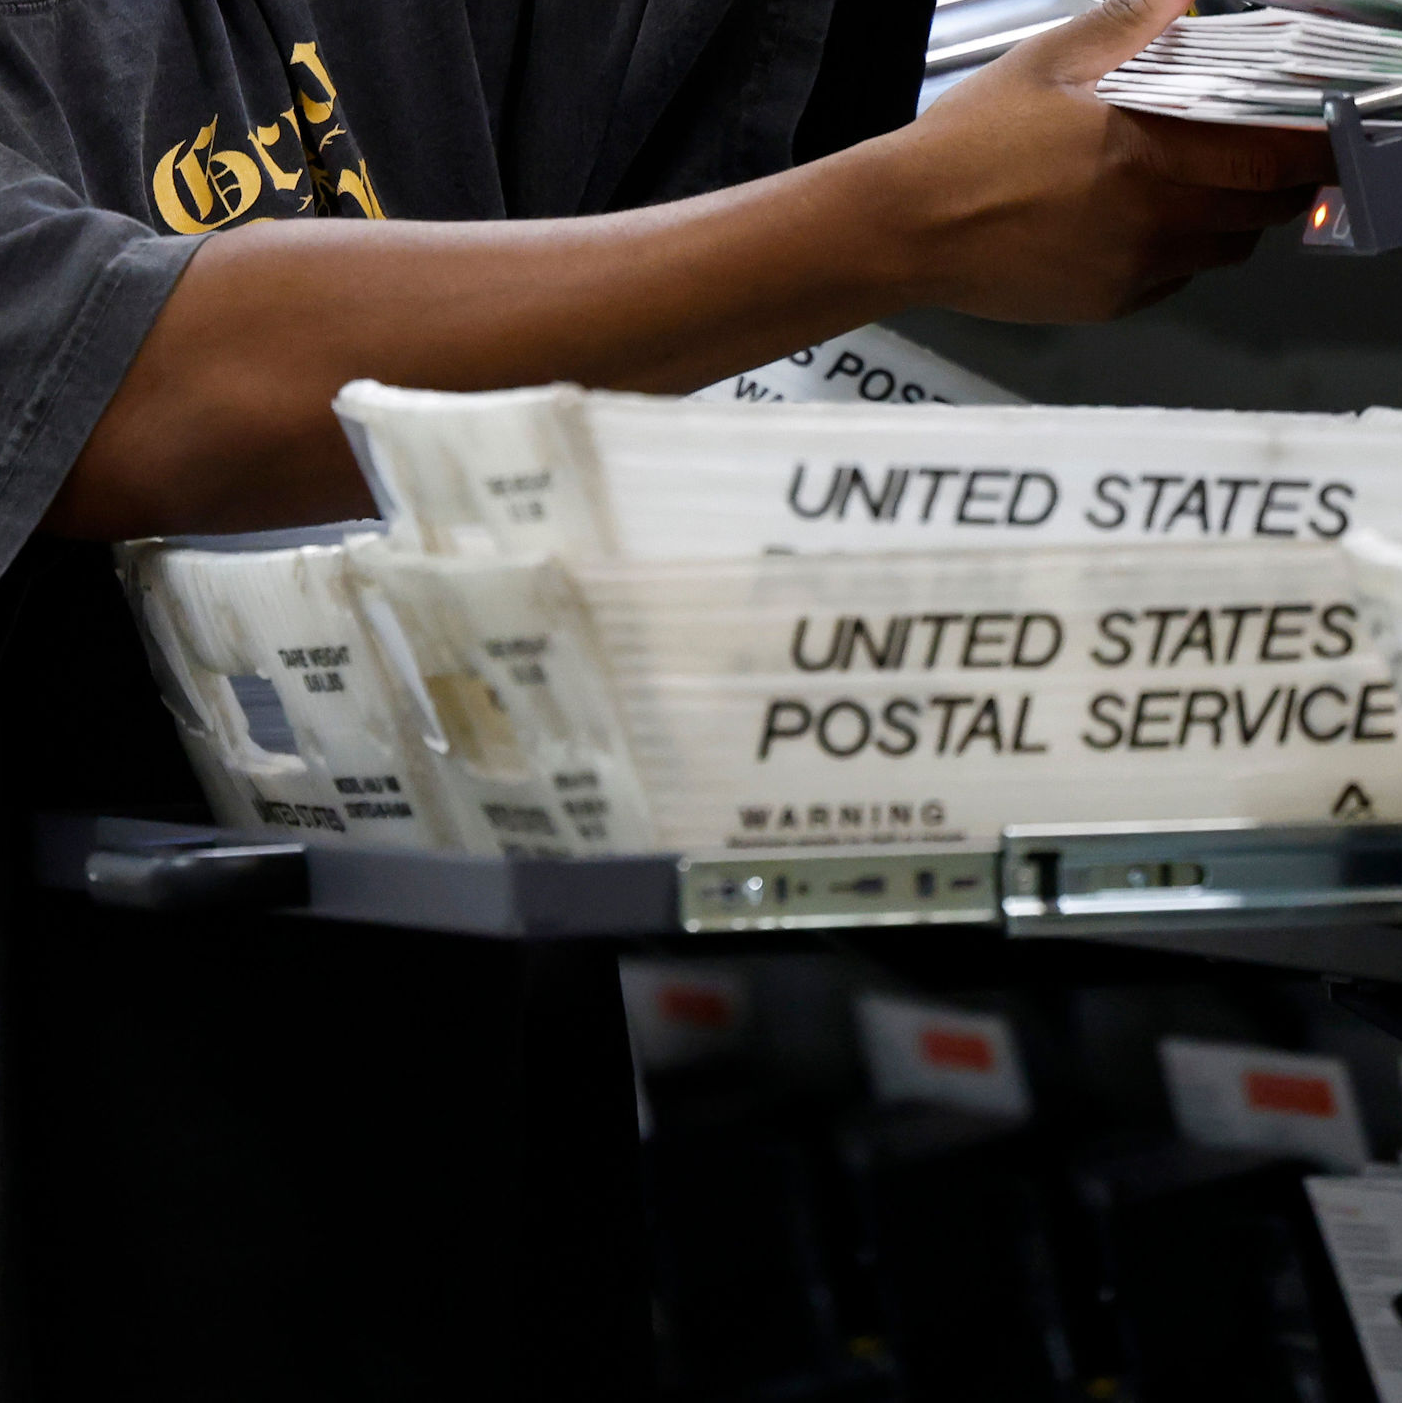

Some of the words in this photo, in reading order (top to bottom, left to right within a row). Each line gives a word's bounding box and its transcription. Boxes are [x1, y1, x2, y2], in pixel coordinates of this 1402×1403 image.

[824, 351, 956, 404] POS
[785, 462, 1060, 526] UNITED
[1084, 473, 1356, 539] STATES
[790, 610, 1063, 673] UNITED
[1089, 603, 1359, 666] STATES
[756, 693, 1047, 762] POSTAL
[1080, 682, 1397, 750] SERVICE
[738, 800, 945, 829] WARNING
